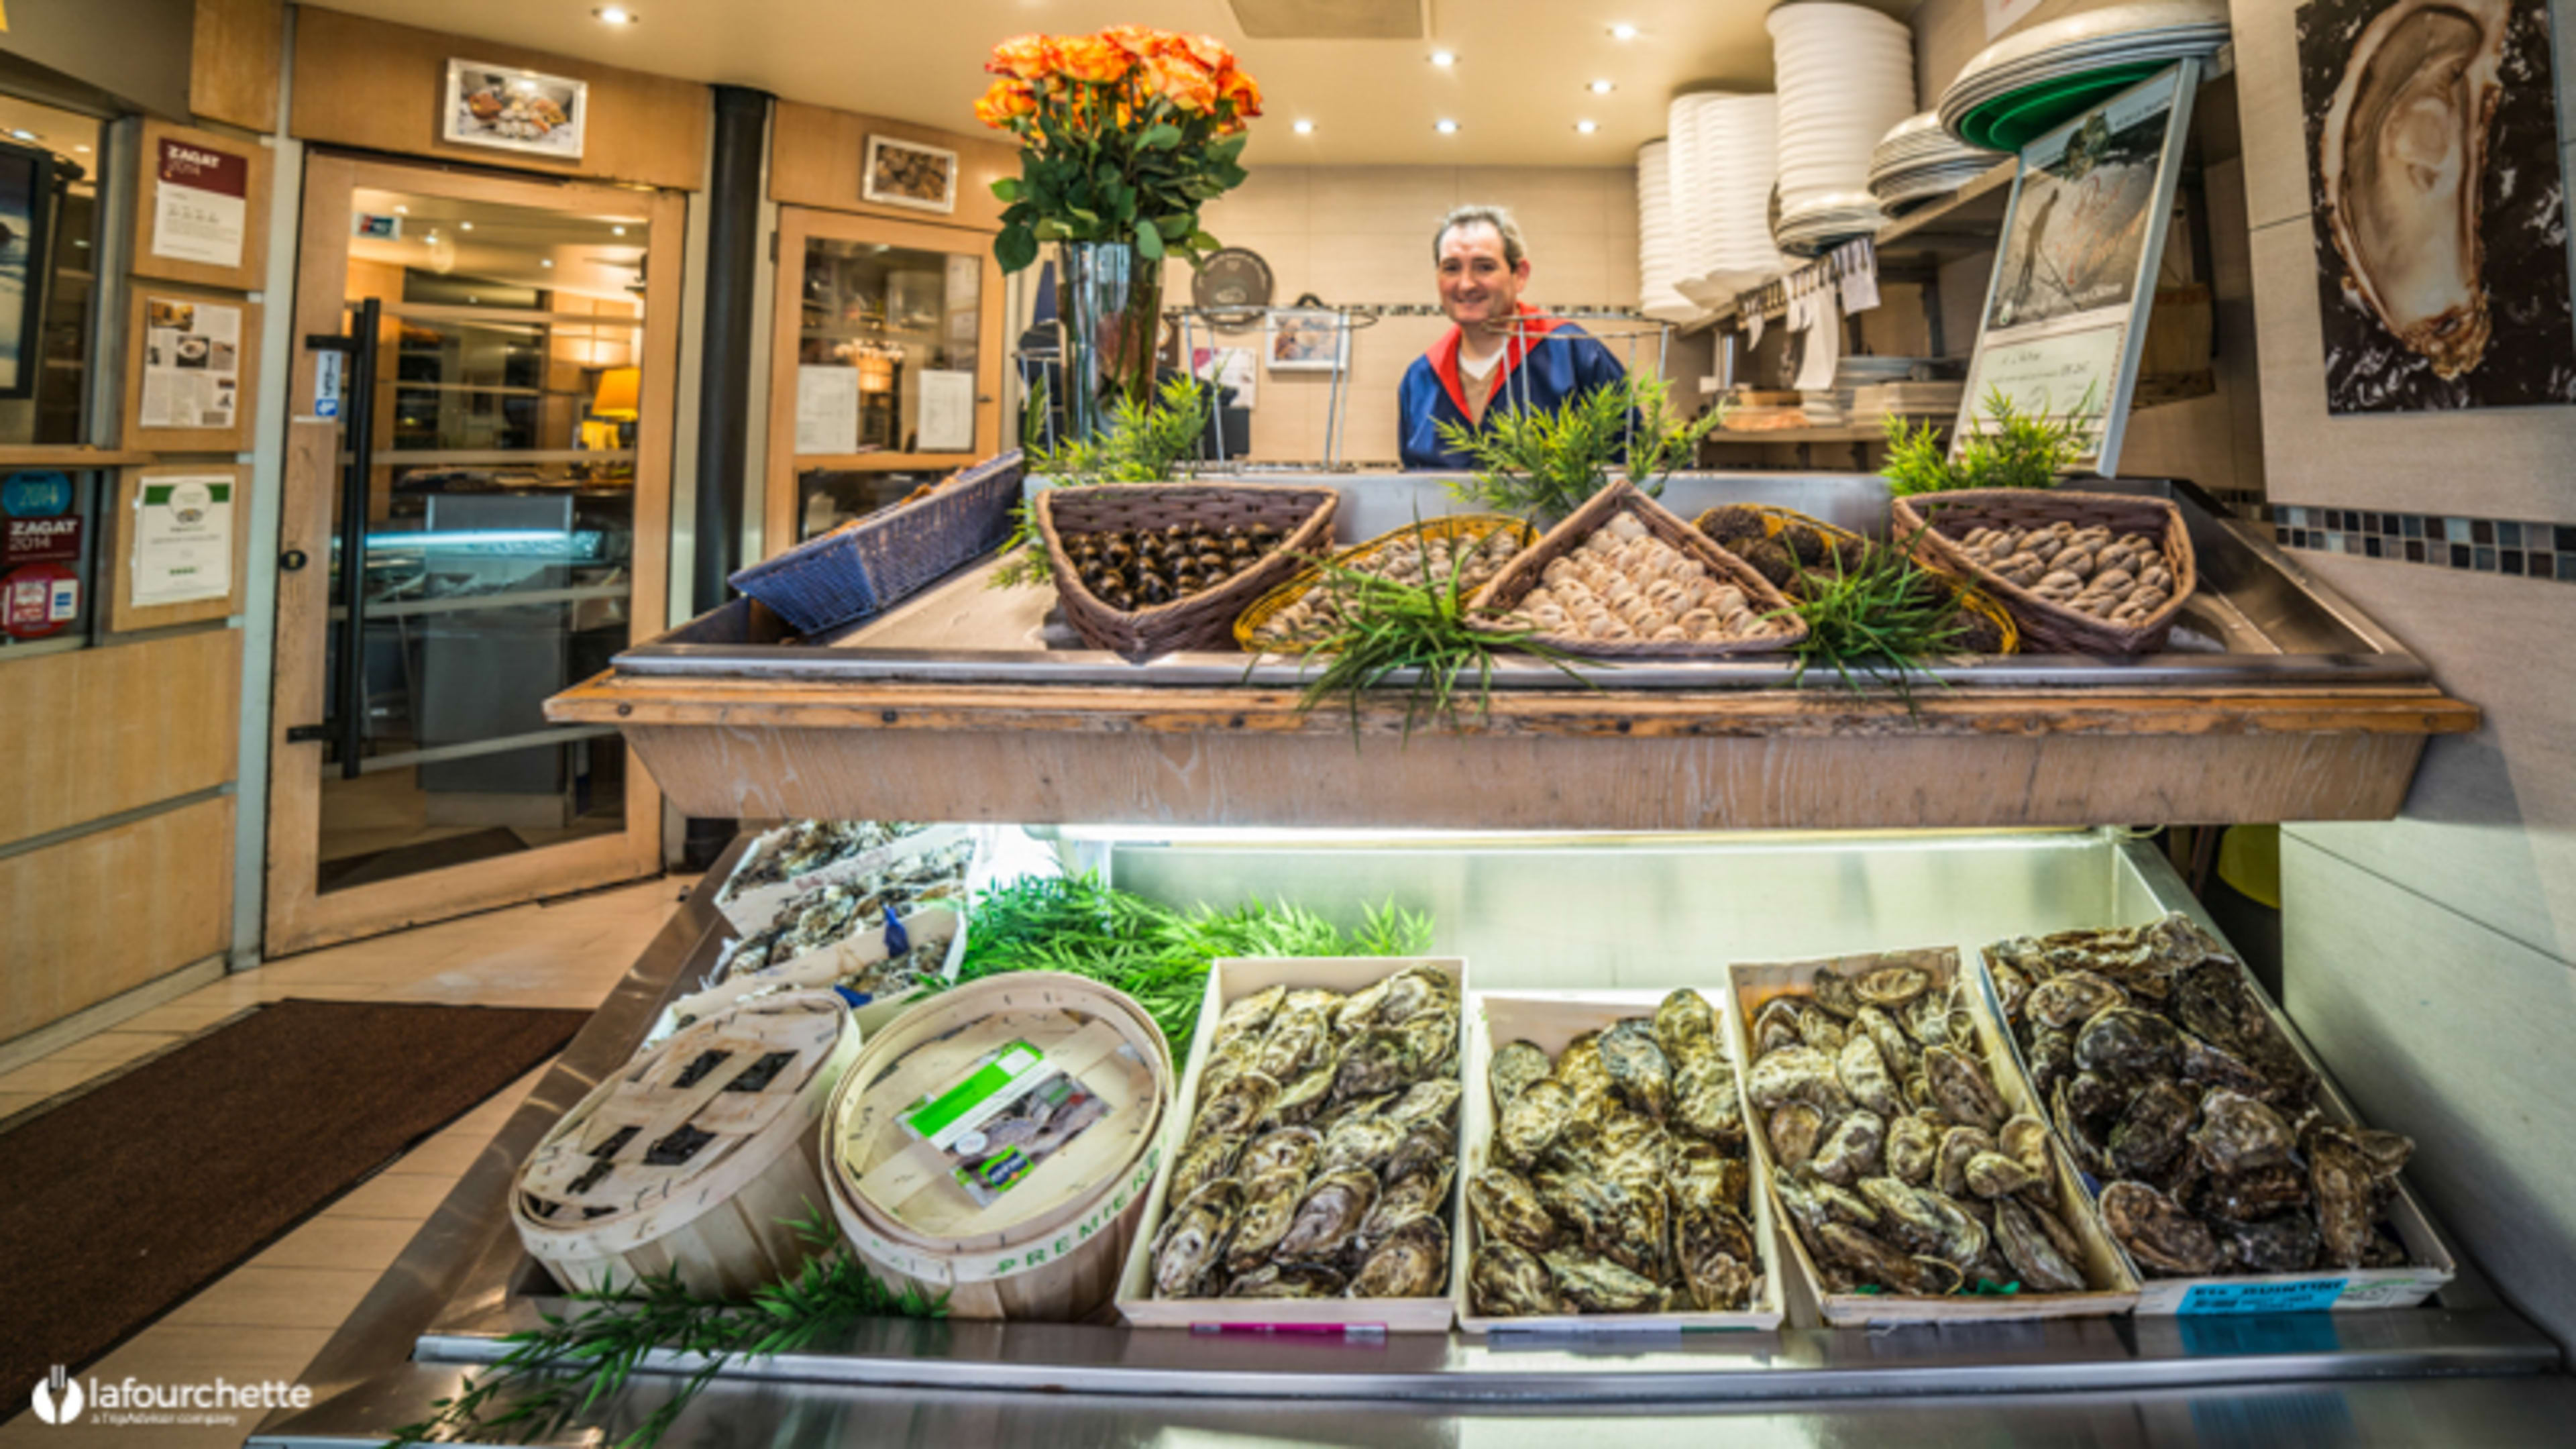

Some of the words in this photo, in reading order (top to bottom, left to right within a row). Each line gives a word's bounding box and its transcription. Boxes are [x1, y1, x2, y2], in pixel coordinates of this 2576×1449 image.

[168, 144, 221, 168] ZAGAT
[11, 519, 78, 536] ZAGAT
[9, 536, 50, 551] 2014
